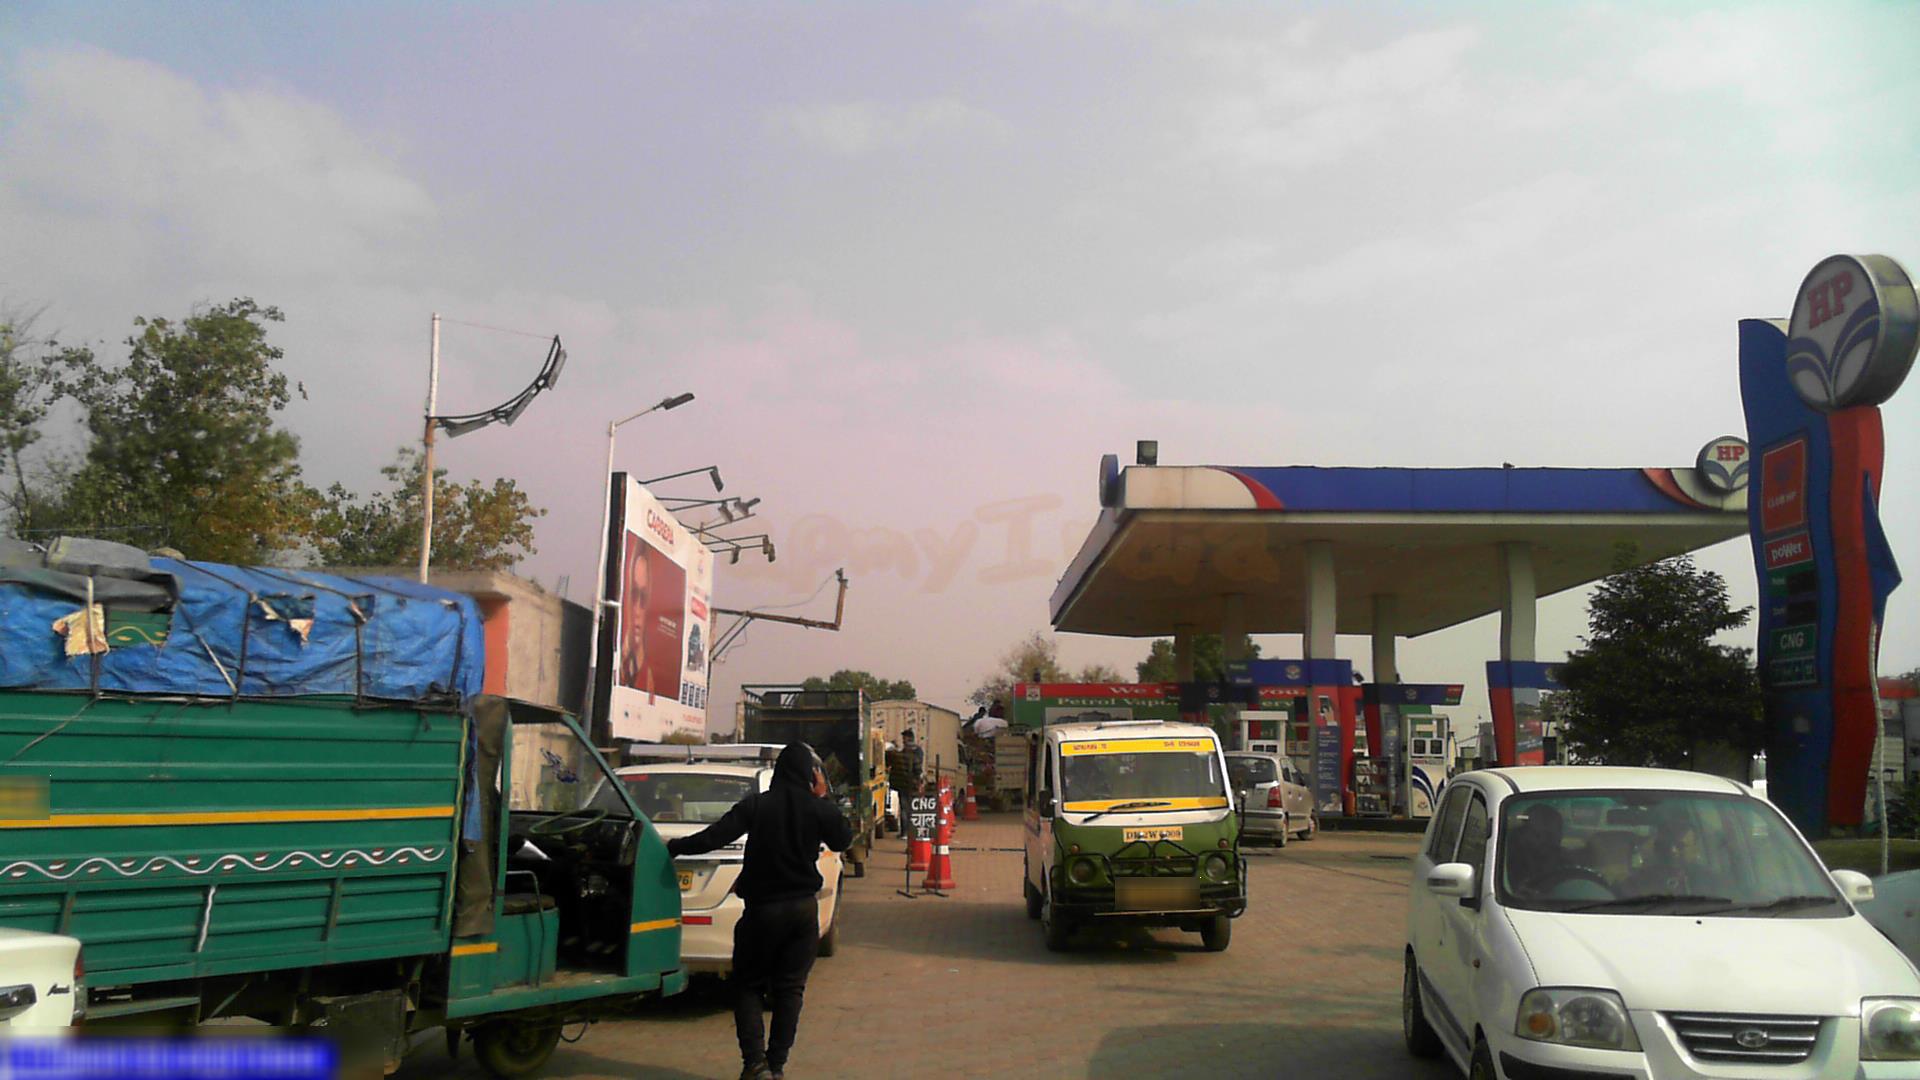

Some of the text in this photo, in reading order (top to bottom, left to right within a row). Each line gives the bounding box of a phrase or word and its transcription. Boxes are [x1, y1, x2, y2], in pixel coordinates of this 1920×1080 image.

[1806, 271, 1853, 330] HP
[1716, 445, 1745, 461] HP
[1780, 631, 1804, 650] CNG
[1109, 686, 1146, 695] We
[1057, 697, 1116, 706] Petrol
[911, 797, 937, 811] CNG
